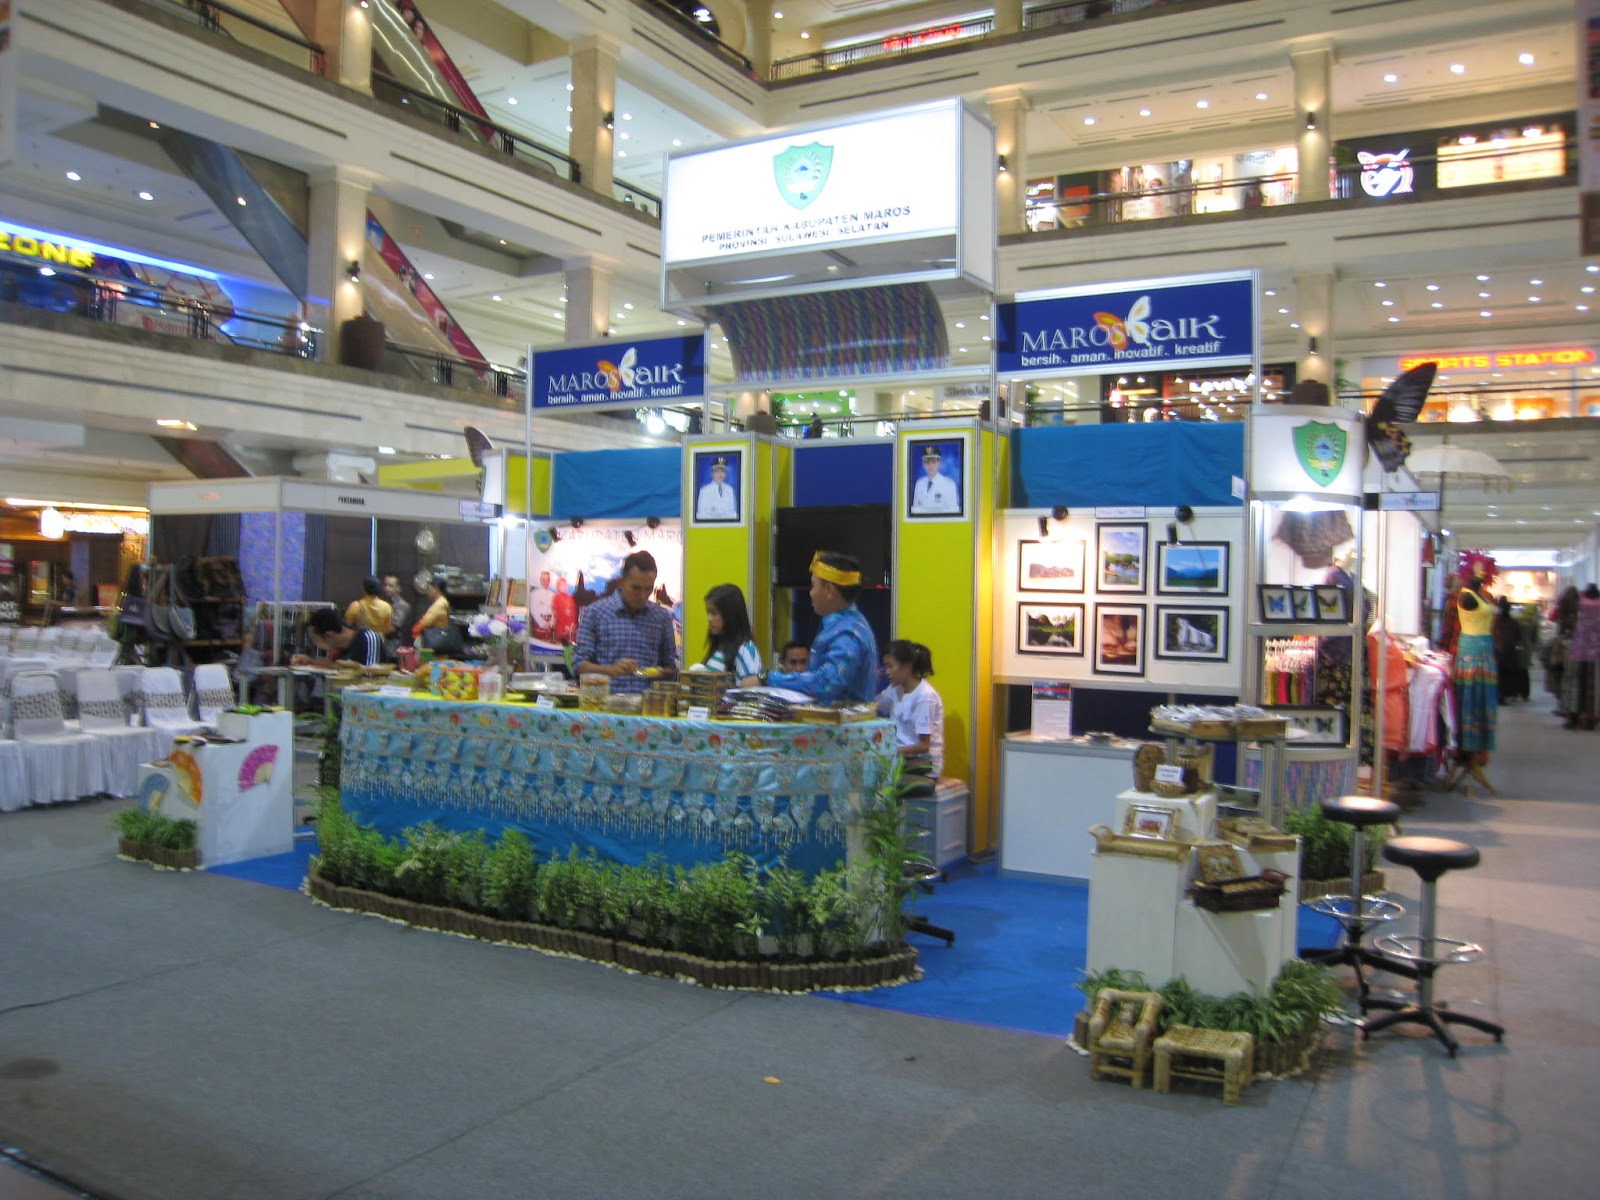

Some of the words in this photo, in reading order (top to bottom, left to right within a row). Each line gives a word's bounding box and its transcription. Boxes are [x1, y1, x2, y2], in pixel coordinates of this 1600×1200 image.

[783, 213, 859, 232] KABUPATEN
[863, 205, 911, 220] MAROS
[838, 221, 889, 235] SELATAN
[1021, 323, 1126, 352] MAROS
[1174, 341, 1221, 355] kreatif
[1495, 350, 1594, 367] STATION
[548, 371, 619, 393] MAROS
[650, 386, 683, 397] kreatif
